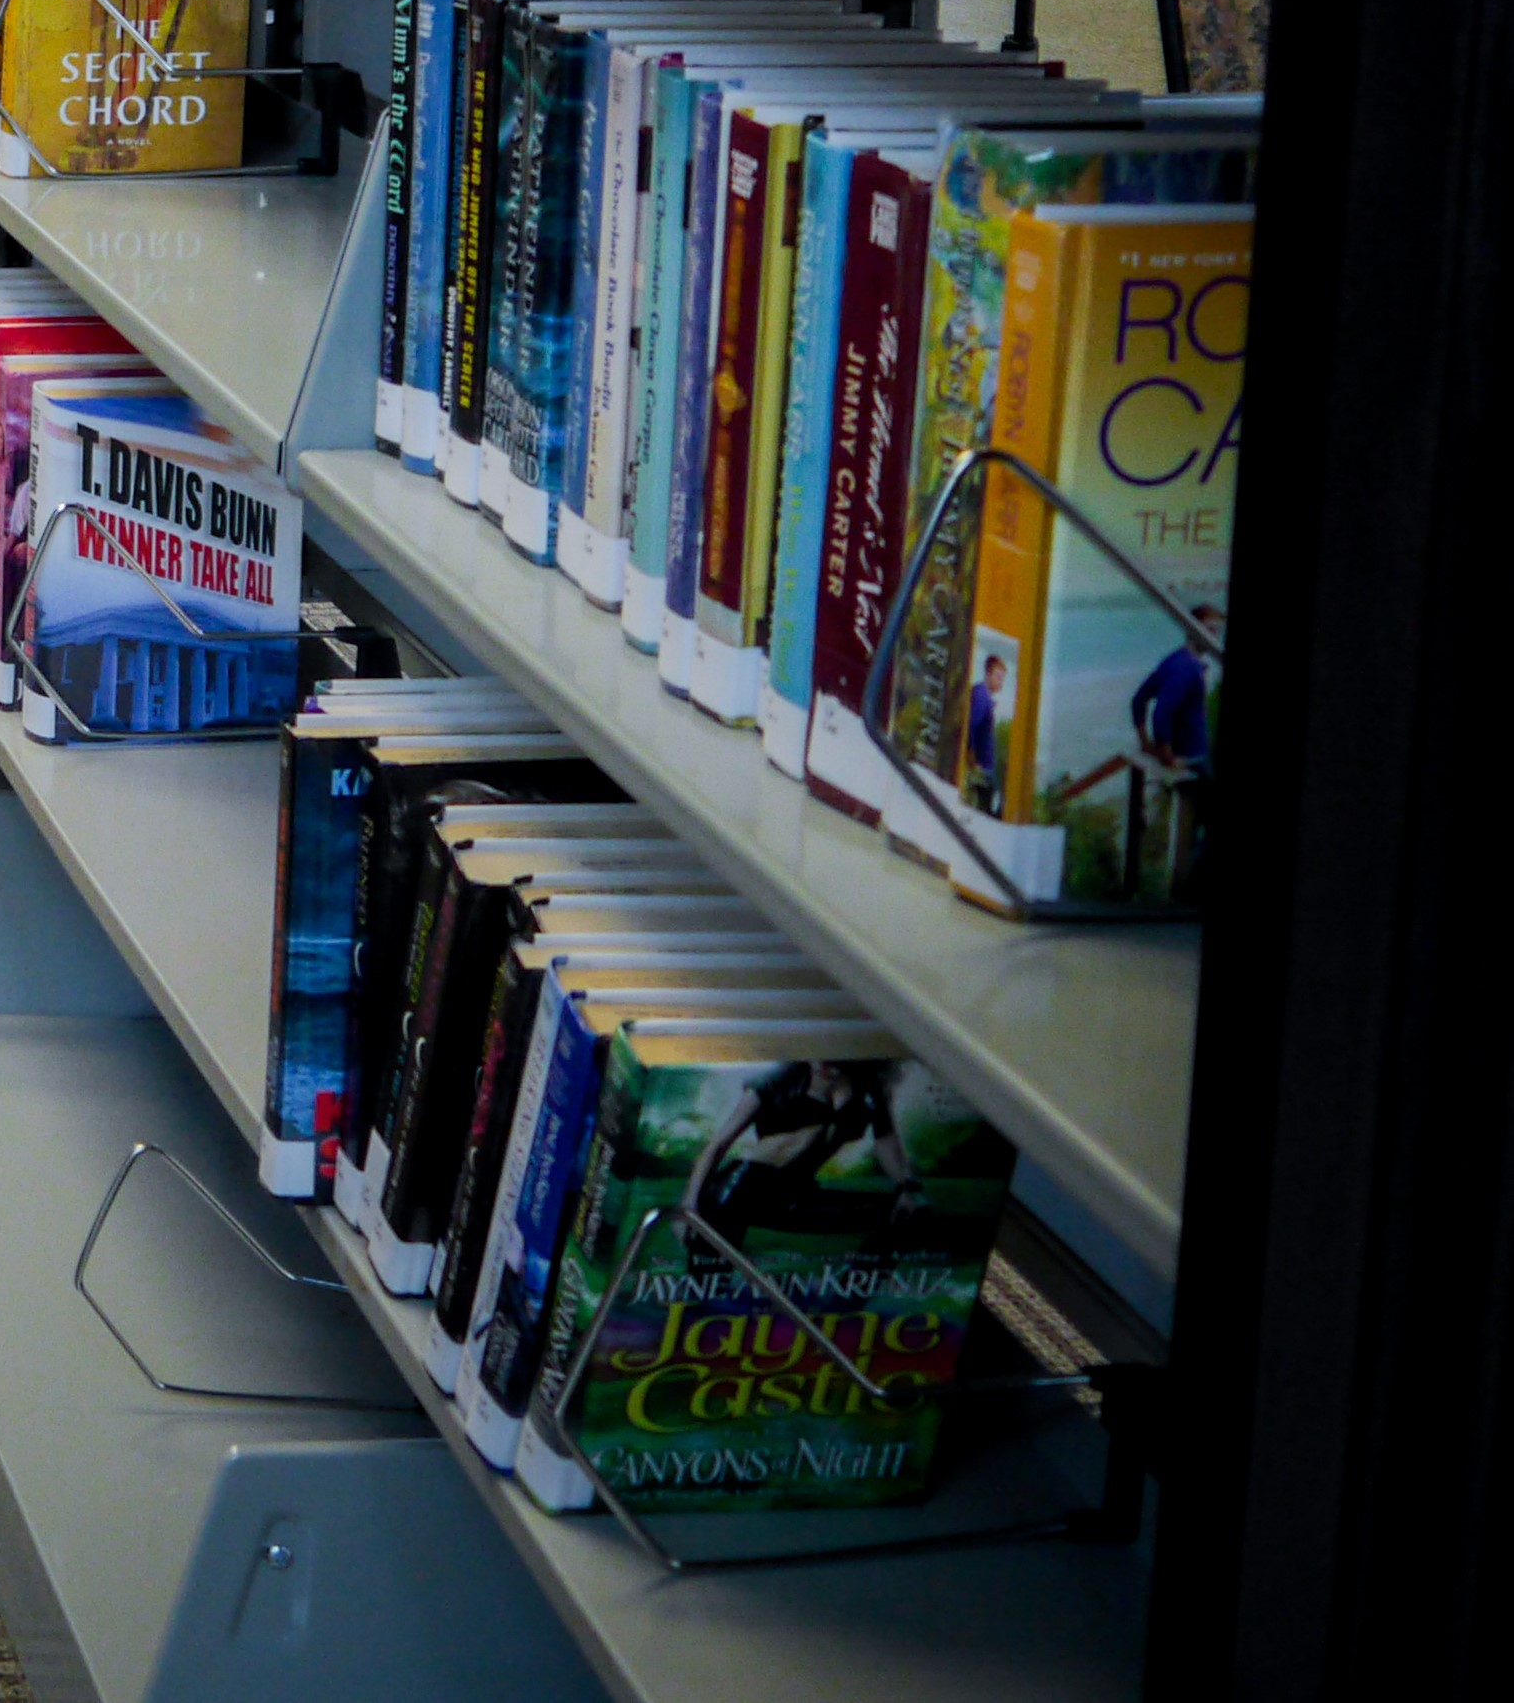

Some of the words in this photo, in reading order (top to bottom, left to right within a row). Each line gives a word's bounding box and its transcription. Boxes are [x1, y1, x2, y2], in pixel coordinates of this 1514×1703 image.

[114, 20, 162, 40] THE
[60, 51, 211, 84] SECRET
[473, 69, 487, 101] THE
[58, 94, 208, 126] CHORD
[118, 138, 152, 146] NOVEL
[390, 92, 411, 131] the
[472, 106, 486, 142] SPY
[384, 138, 410, 215] Word
[470, 149, 484, 185] WHO
[581, 99, 595, 188] Peter
[460, 164, 470, 230] THOMAS
[466, 195, 482, 259] JUMPED
[497, 95, 526, 347] PATHFINDER
[606, 162, 625, 270] Chocolate
[518, 112, 545, 371] PATHFINDER
[649, 192, 668, 302] Chocolate
[1148, 251, 1185, 267] NEW
[1193, 251, 1236, 267] YORK
[465, 265, 478, 299] OFF
[605, 277, 619, 333] Book
[444, 286, 456, 348] DOROTHY
[463, 304, 476, 335] THE
[646, 314, 662, 381] Clown
[441, 349, 453, 412] CANNELL
[459, 340, 475, 409] SCREEN
[600, 340, 616, 412] Bandit
[835, 341, 865, 455] JIMMY
[640, 388, 656, 464] Corpse
[77, 422, 102, 496] T.
[109, 436, 204, 531] DAVIS
[211, 481, 277, 557] BUNN
[77, 506, 183, 583] WINNER
[190, 540, 240, 597] TAKE
[245, 559, 274, 606] ALL
[825, 468, 857, 600] CARTER
[1136, 508, 1220, 547] THE
[609, 1301, 942, 1375] Jayne
[625, 1362, 927, 1433] Castle
